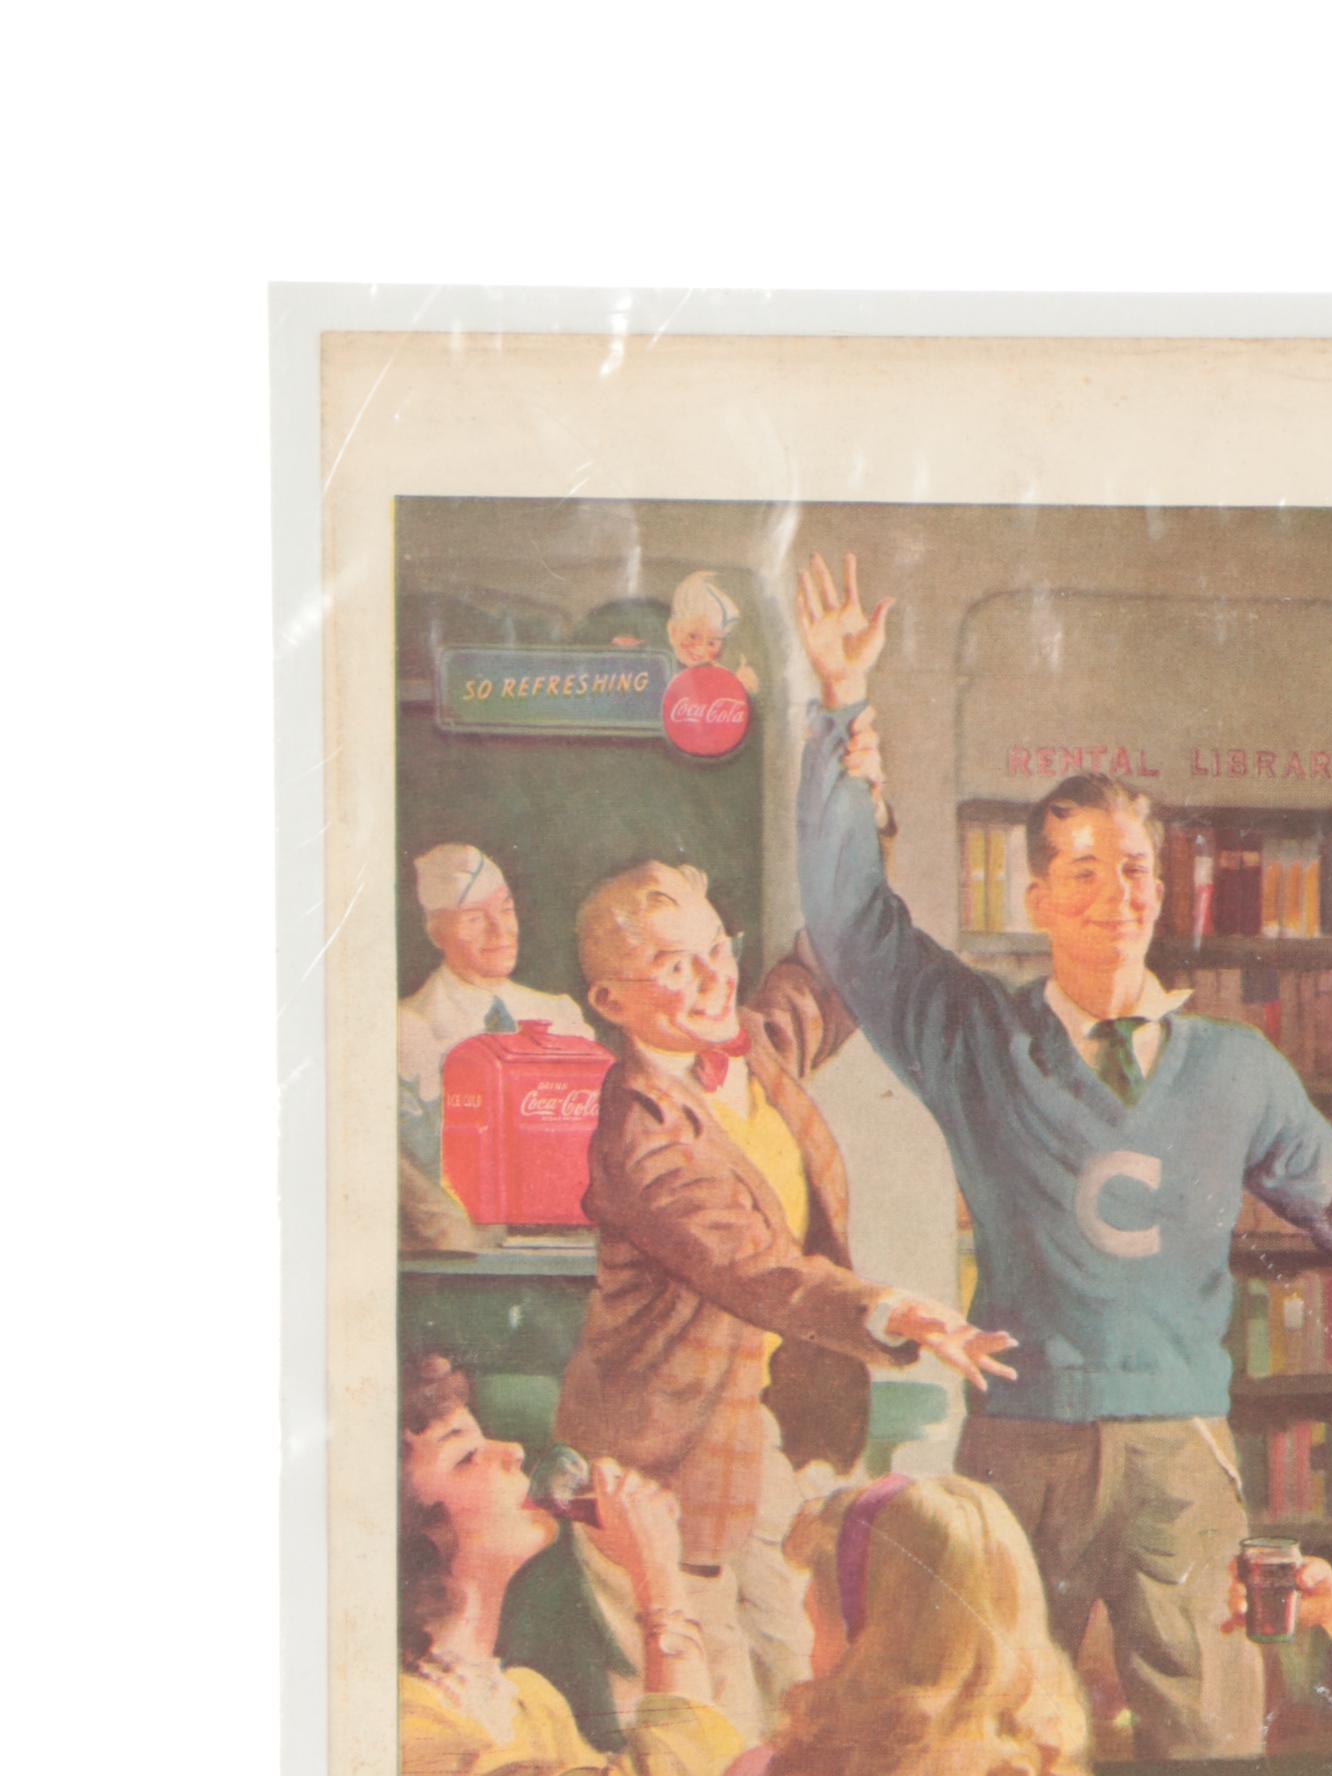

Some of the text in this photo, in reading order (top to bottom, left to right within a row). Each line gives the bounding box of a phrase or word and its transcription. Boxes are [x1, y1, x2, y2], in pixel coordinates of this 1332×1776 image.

[463, 672, 650, 701] SO REFRESHING
[1008, 745, 1160, 778] RENTAL
[1076, 1150, 1163, 1257] C
